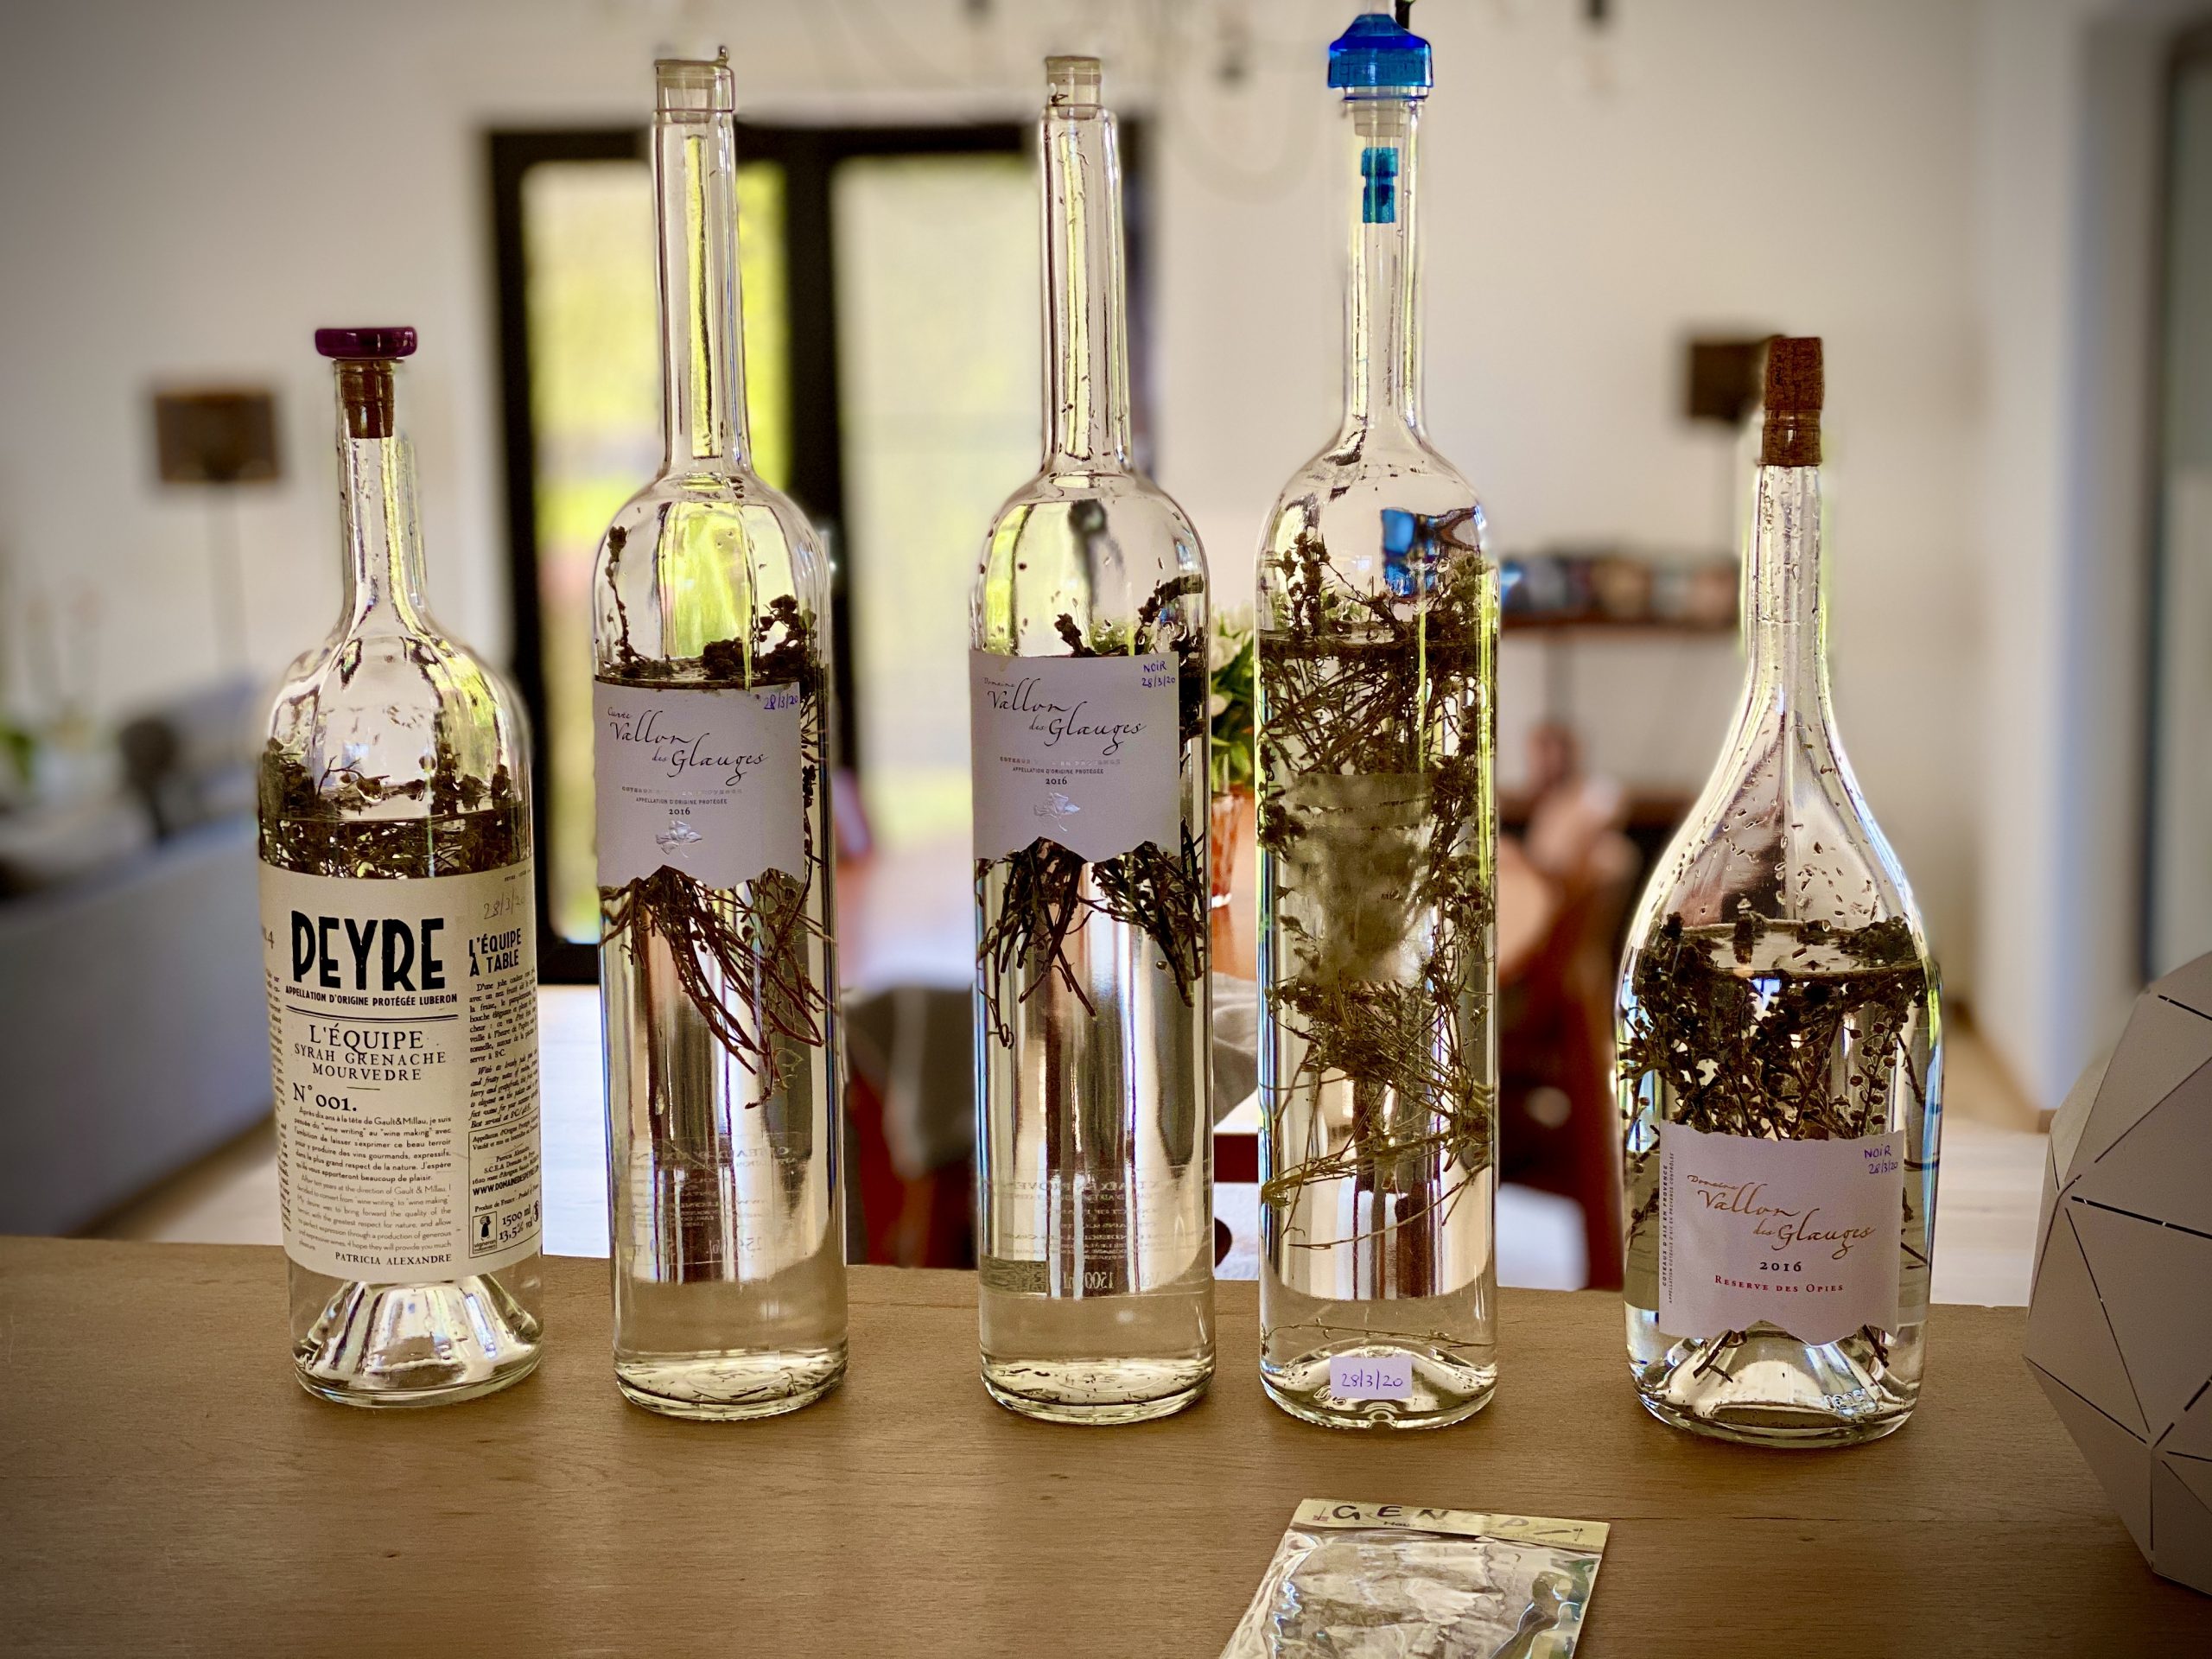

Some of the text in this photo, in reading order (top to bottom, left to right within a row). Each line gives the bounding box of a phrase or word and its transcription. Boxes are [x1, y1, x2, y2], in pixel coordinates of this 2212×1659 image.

[1143, 660, 1167, 673] NOIR
[1142, 676, 1176, 688] 28/3/20
[764, 692, 798, 709] 28/3/20
[988, 678, 1072, 713] Vallon
[610, 710, 693, 744] Vallon
[1029, 701, 1147, 755] des Glauges
[652, 733, 768, 786] des Glauges
[1045, 776, 1067, 785] 2016
[669, 807, 691, 815] 2016
[291, 910, 445, 991] PEYRE
[469, 928, 521, 957] L'ÉQUIPE
[486, 949, 519, 973] TABLE
[285, 985, 458, 1007] APPELLATION D'ORIGINE PROTÉGÉE LUBERON
[470, 1013, 489, 1022] bouche
[309, 1024, 424, 1054] L'ÉQUIPE
[294, 1043, 447, 1066] SYRAH GRENACHE
[312, 1063, 422, 1081] MOURVEDRE
[299, 1106, 315, 1116] Après
[364, 1116, 372, 1124] de
[429, 1117, 436, 1126] je
[1864, 1144, 1892, 1159] NOIR
[1868, 1161, 1898, 1175] 28/3/20
[361, 1173, 395, 1183] beaucoup
[1687, 1174, 1739, 1191] Domaine
[1697, 1182, 1801, 1217] Vallon
[502, 1210, 522, 1226] 1500
[1663, 1210, 1667, 1221] EN
[1752, 1208, 1876, 1259] des Glauges
[336, 1252, 452, 1265] PATRICIA ALEXANDRE
[1759, 1261, 1802, 1272] 2016
[1342, 1368, 1403, 1390] 28/3/20
